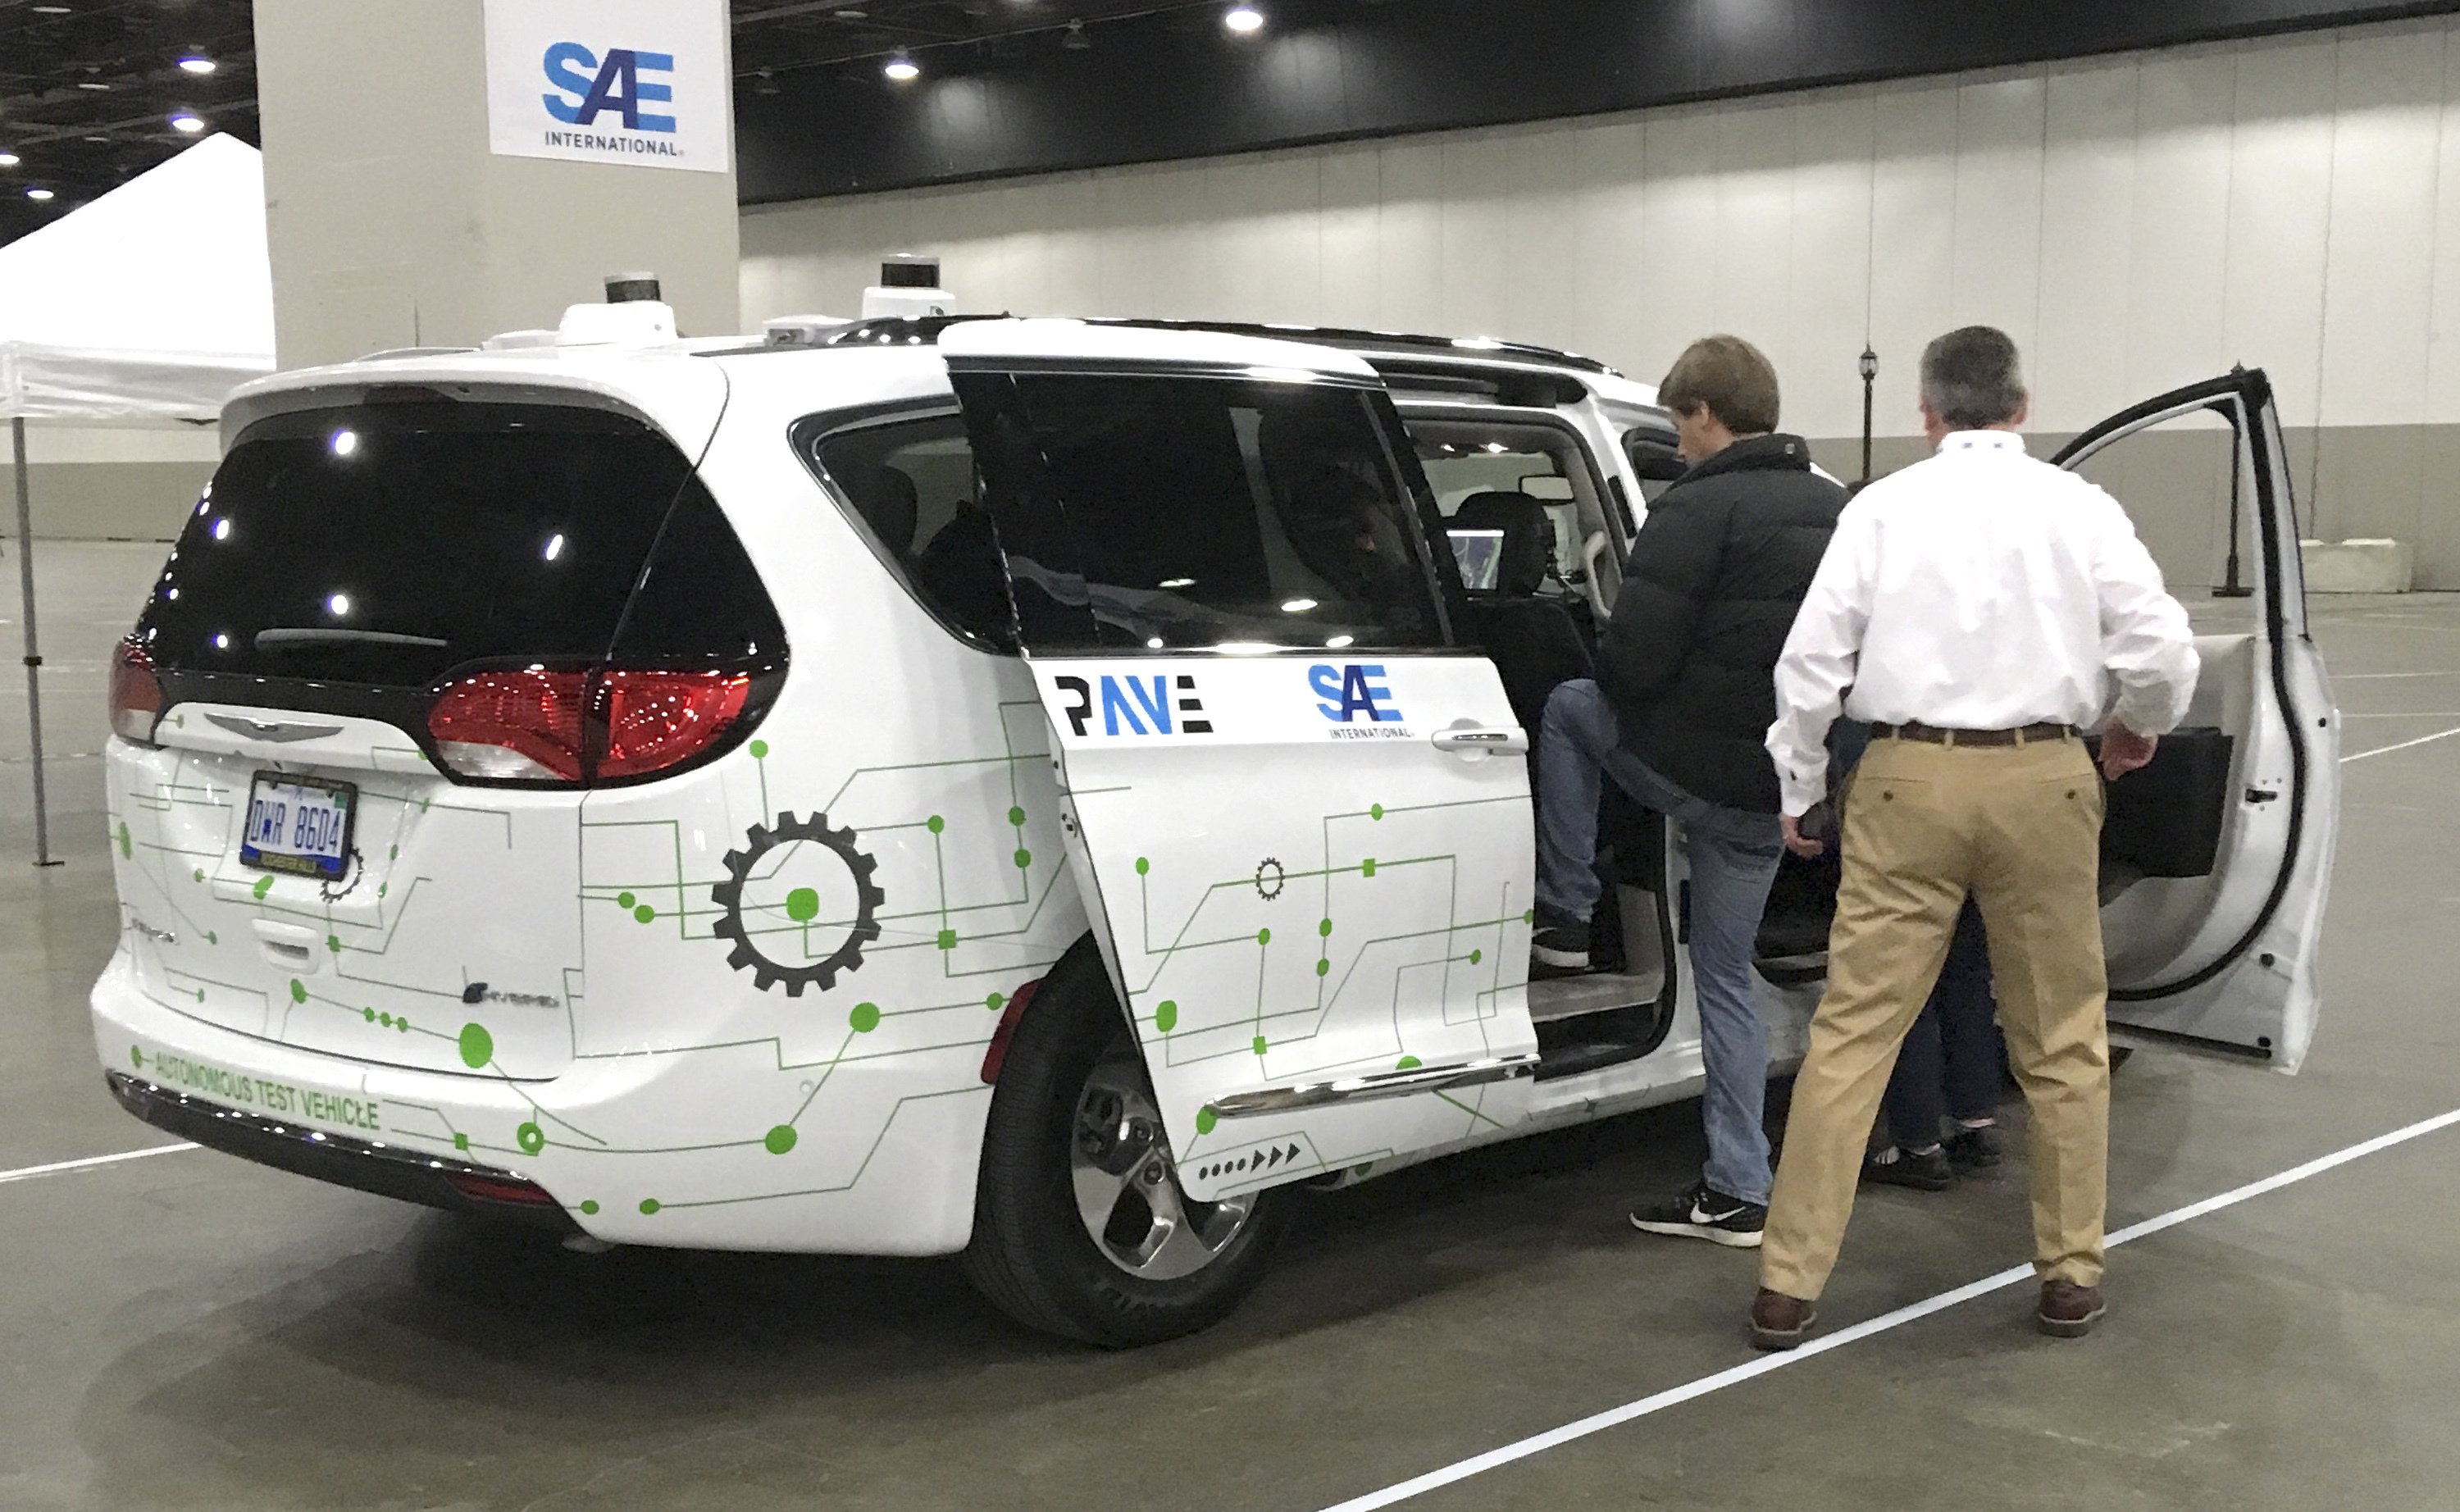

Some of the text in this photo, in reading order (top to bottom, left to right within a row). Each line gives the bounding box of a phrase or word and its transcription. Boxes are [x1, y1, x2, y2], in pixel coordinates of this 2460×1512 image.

[542, 42, 676, 133] SAE
[545, 131, 678, 157] INTERNATIONAL
[1308, 664, 1404, 722] SAE
[1328, 726, 1411, 740] INTERNATIONAL
[294, 805, 340, 853] 8604
[156, 1051, 380, 1130] AUTONOMOUS TEST VEHICLE
